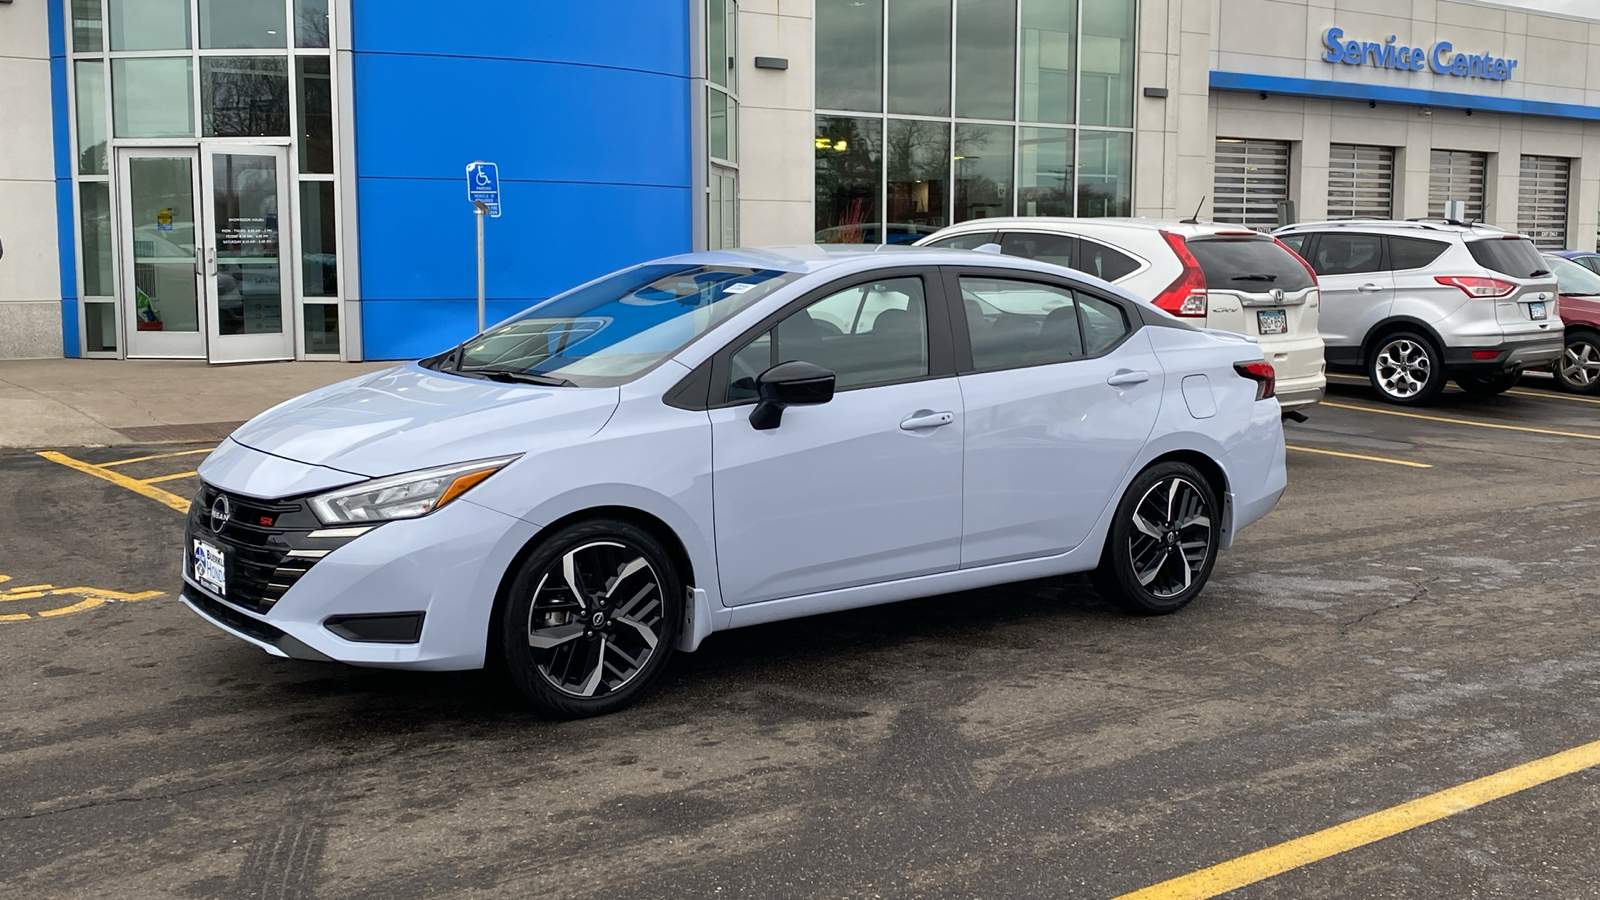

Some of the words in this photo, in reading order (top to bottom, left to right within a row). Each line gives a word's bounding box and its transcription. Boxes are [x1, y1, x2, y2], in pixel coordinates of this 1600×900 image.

[1322, 27, 1425, 71] Service
[1428, 41, 1518, 81] Center
[260, 516, 273, 526] SR
[207, 560, 225, 583] HOND
